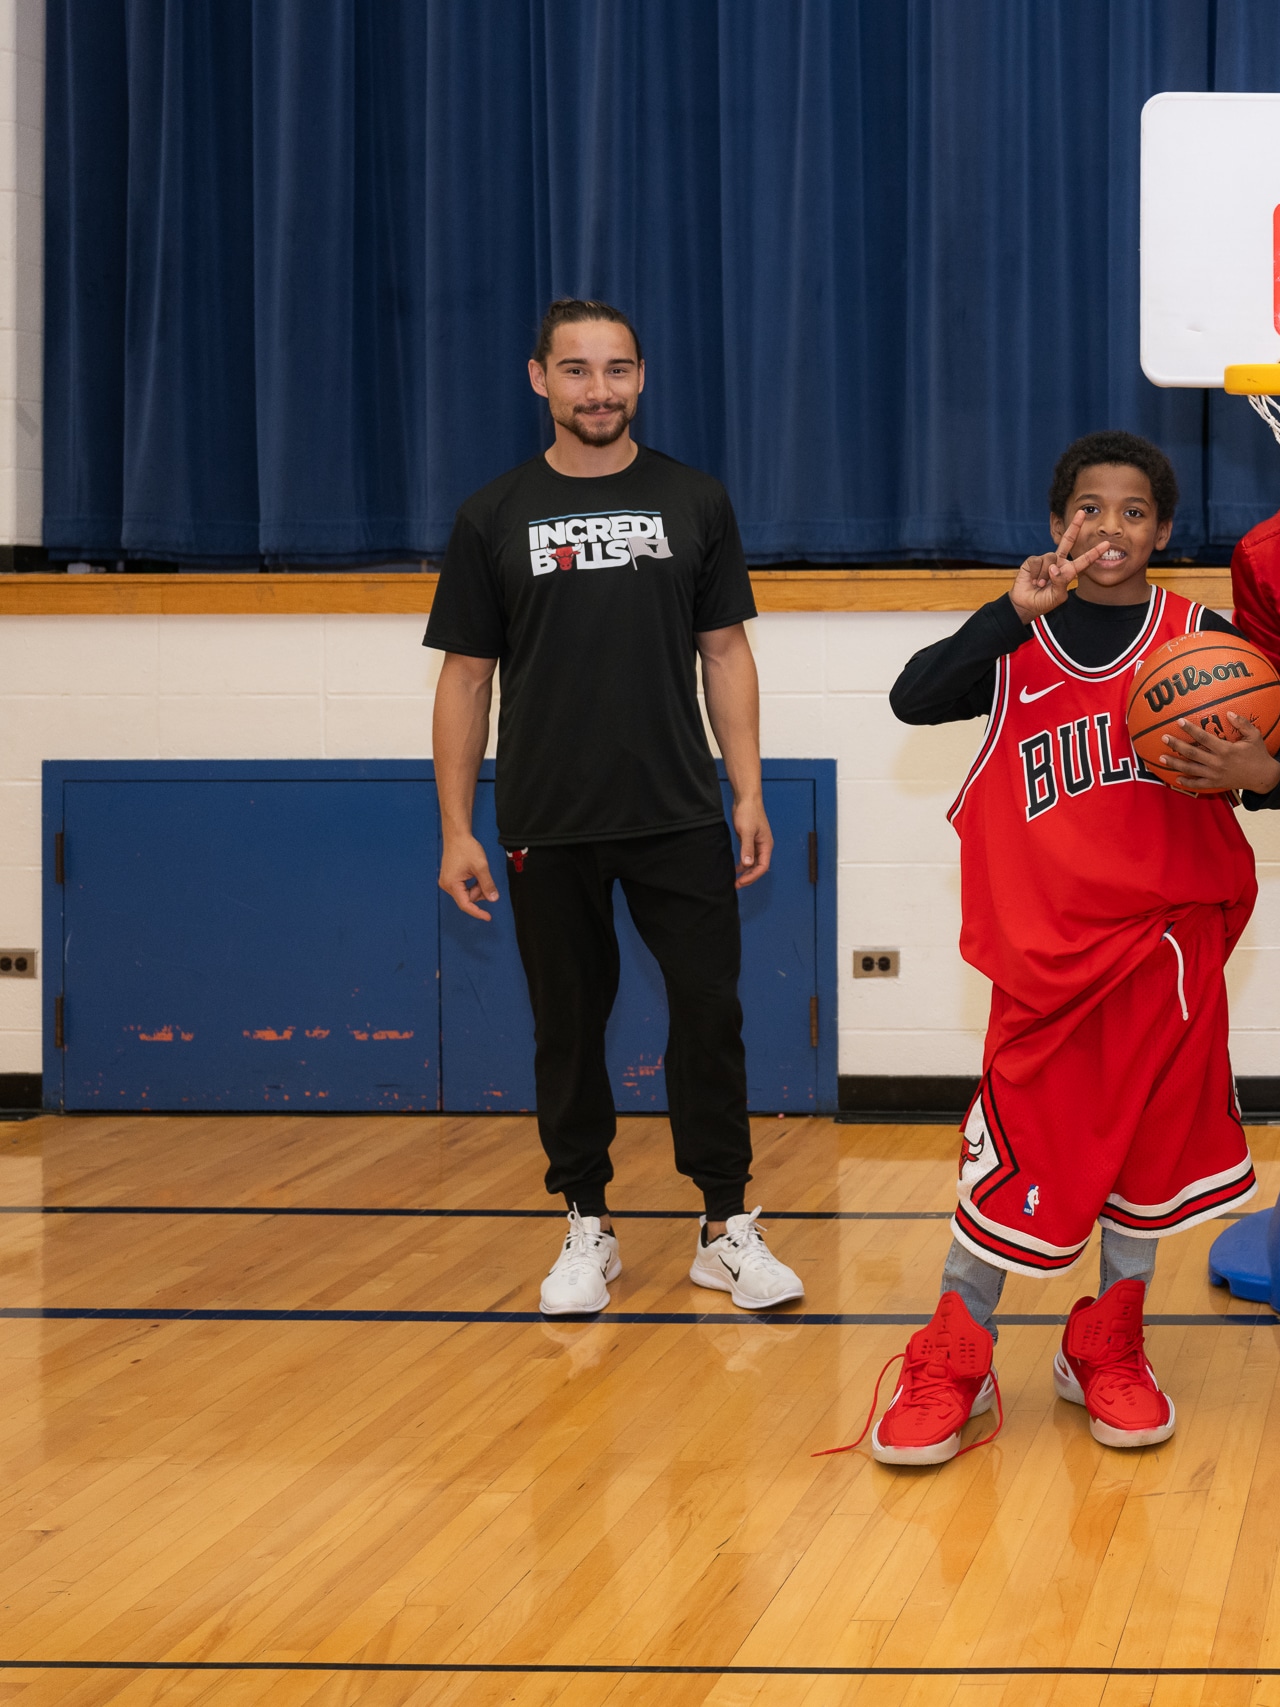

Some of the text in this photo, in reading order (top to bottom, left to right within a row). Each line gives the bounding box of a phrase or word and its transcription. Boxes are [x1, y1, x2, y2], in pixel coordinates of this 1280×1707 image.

[529, 515, 665, 550] INCREDI
[1143, 661, 1252, 713] Wilson
[1019, 712, 1168, 822] BUL
